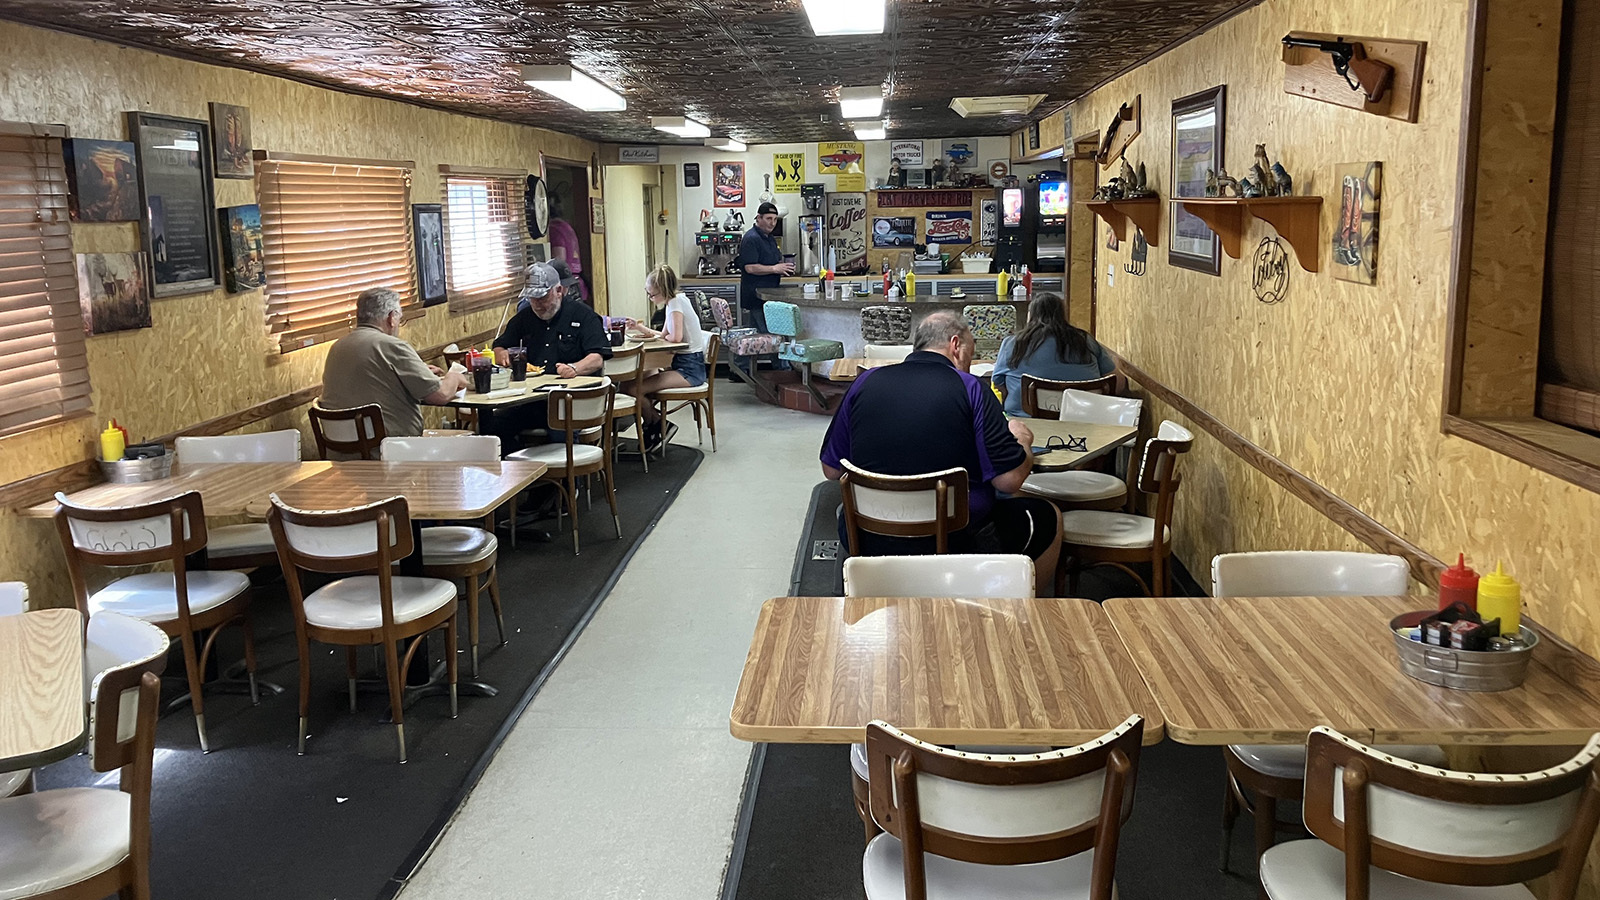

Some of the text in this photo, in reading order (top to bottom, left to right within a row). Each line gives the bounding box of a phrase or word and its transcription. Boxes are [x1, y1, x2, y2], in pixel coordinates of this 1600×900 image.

[893, 143, 921, 151] INTERNATIONAL
[901, 192, 952, 206] HARVESTER
[829, 207, 866, 231] Coffee
[837, 239, 847, 248] ONE
